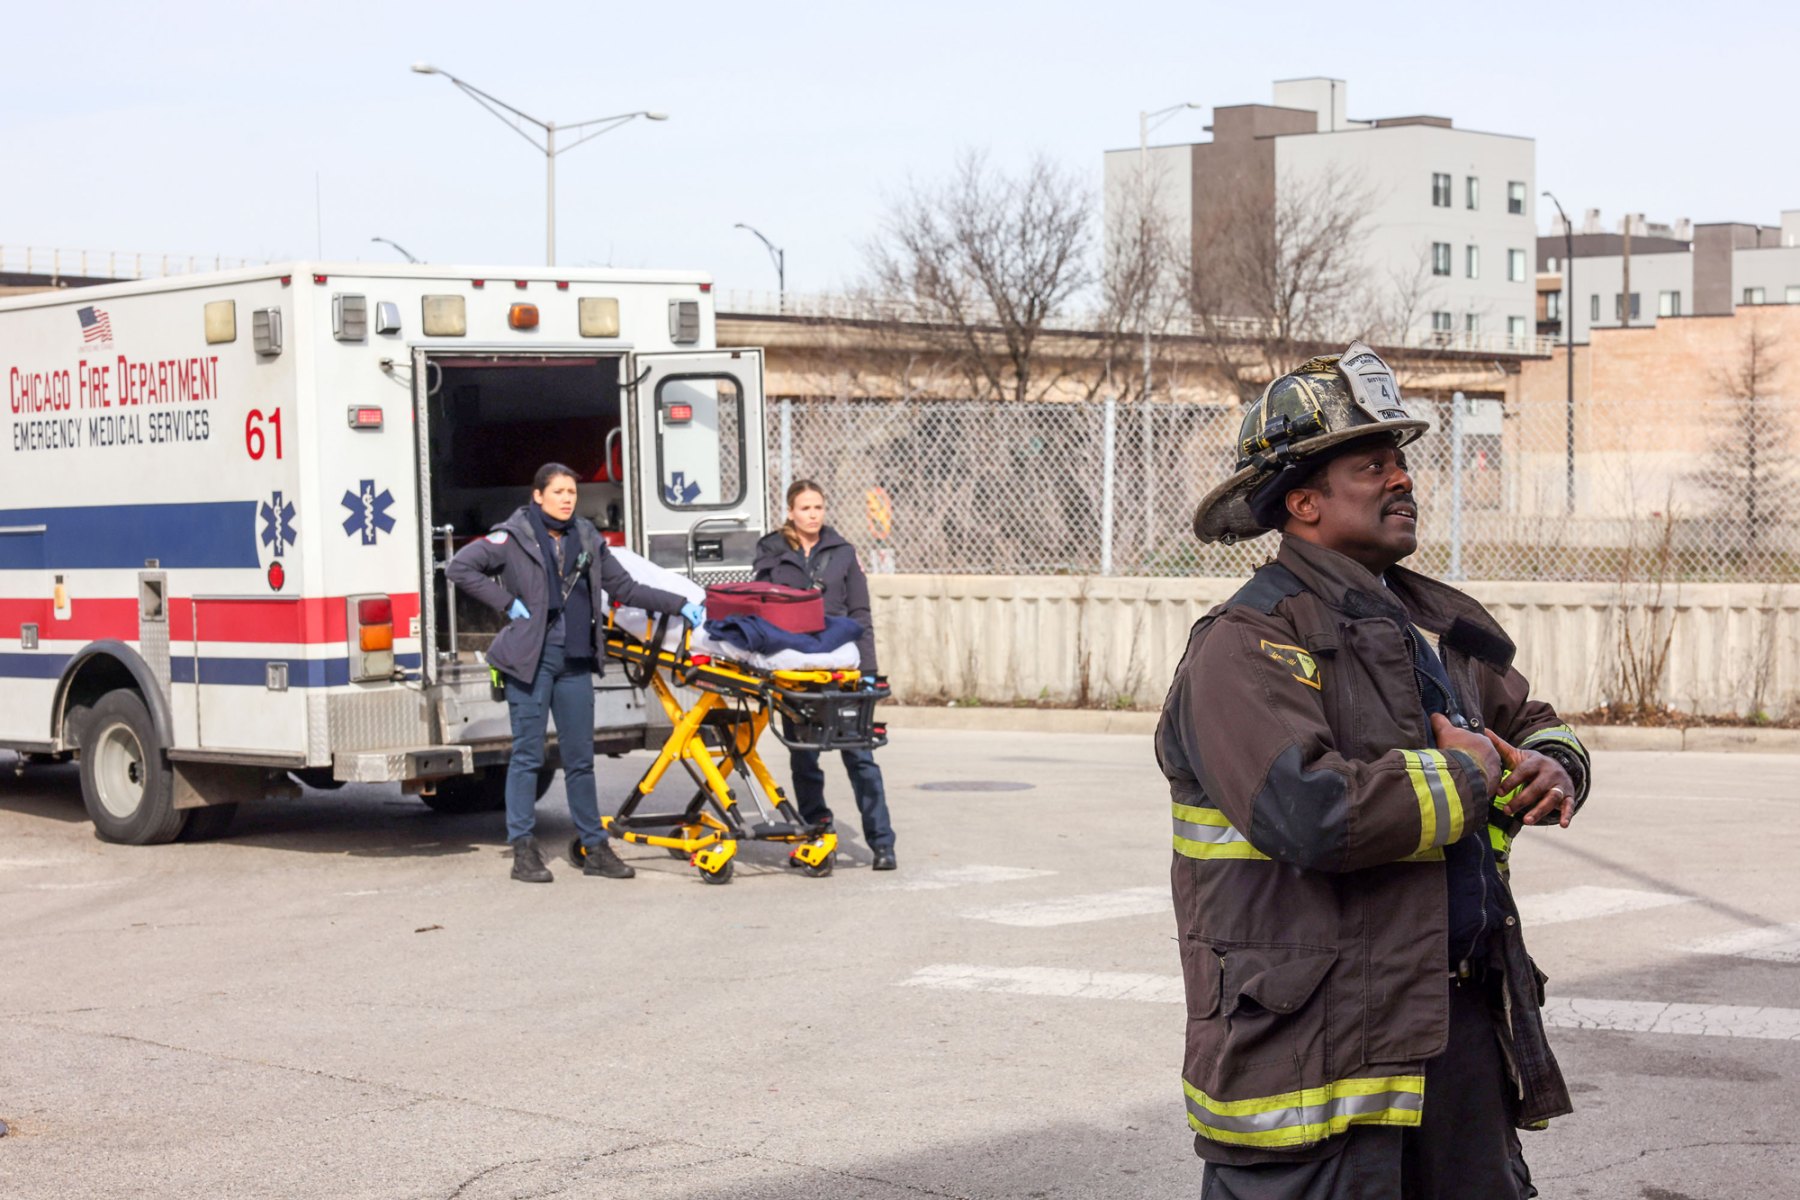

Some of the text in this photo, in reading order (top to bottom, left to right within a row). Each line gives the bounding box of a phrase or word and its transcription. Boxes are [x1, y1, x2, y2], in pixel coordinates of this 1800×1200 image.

[10, 355, 218, 414] CHICAGO FIRE DEPARTMENT
[1381, 384, 1391, 400] 4
[13, 409, 209, 452] EMERGENCY MEDICAL SERVICES
[245, 407, 283, 461] 61
